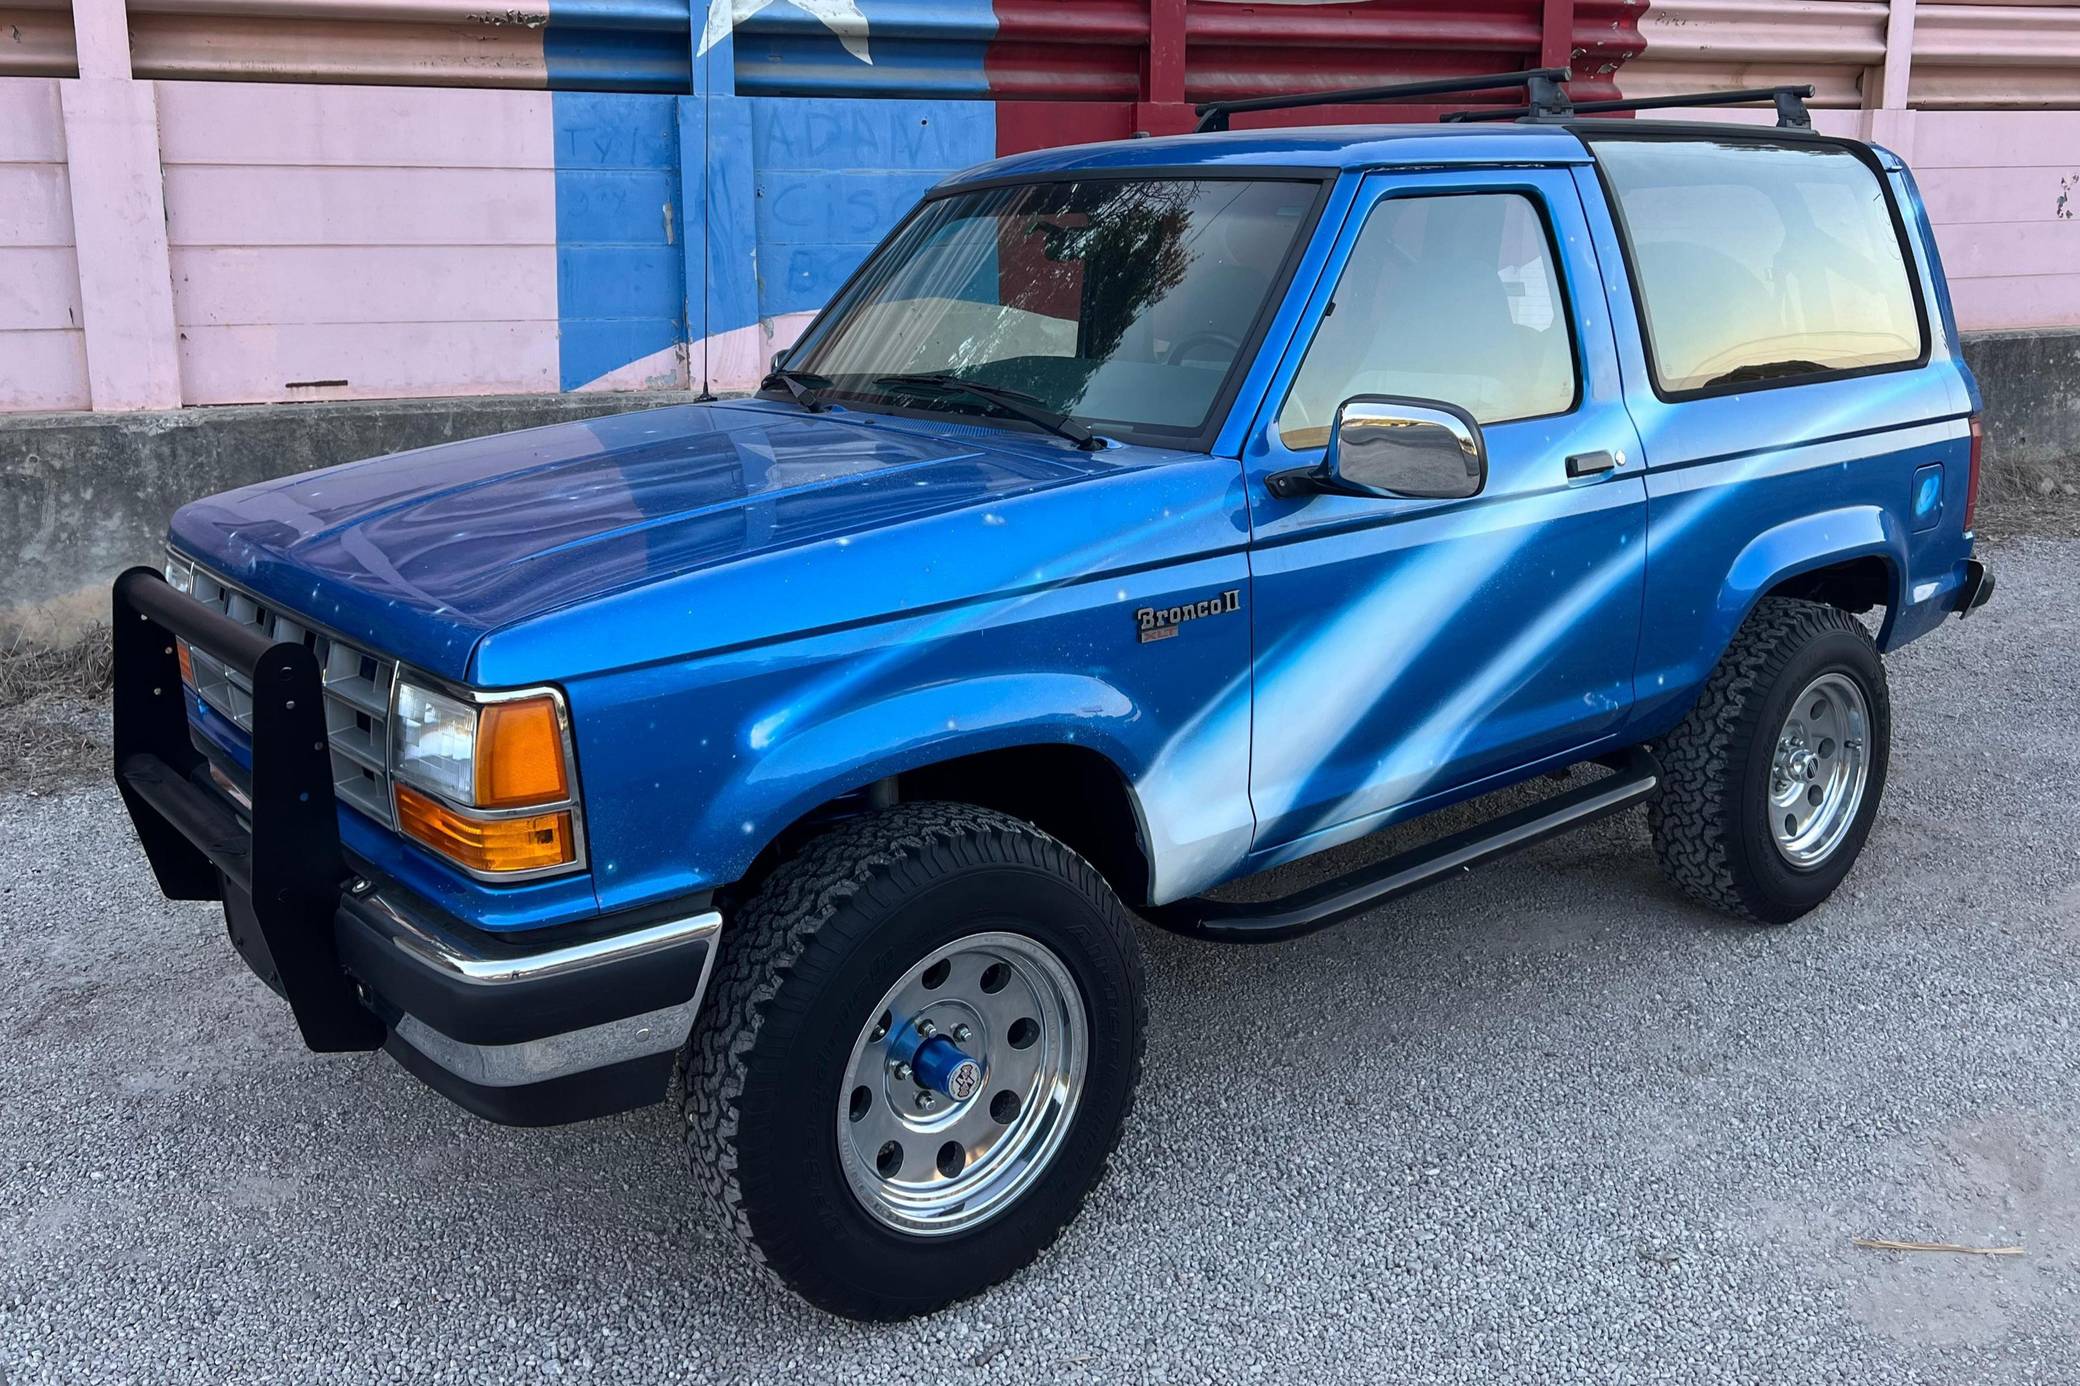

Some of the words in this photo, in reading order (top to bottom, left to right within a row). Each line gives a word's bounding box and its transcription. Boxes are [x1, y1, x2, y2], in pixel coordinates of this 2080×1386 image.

[1137, 598, 1222, 630] Bronco
[1223, 589, 1241, 613] II
[1142, 627, 1178, 642] XLT
